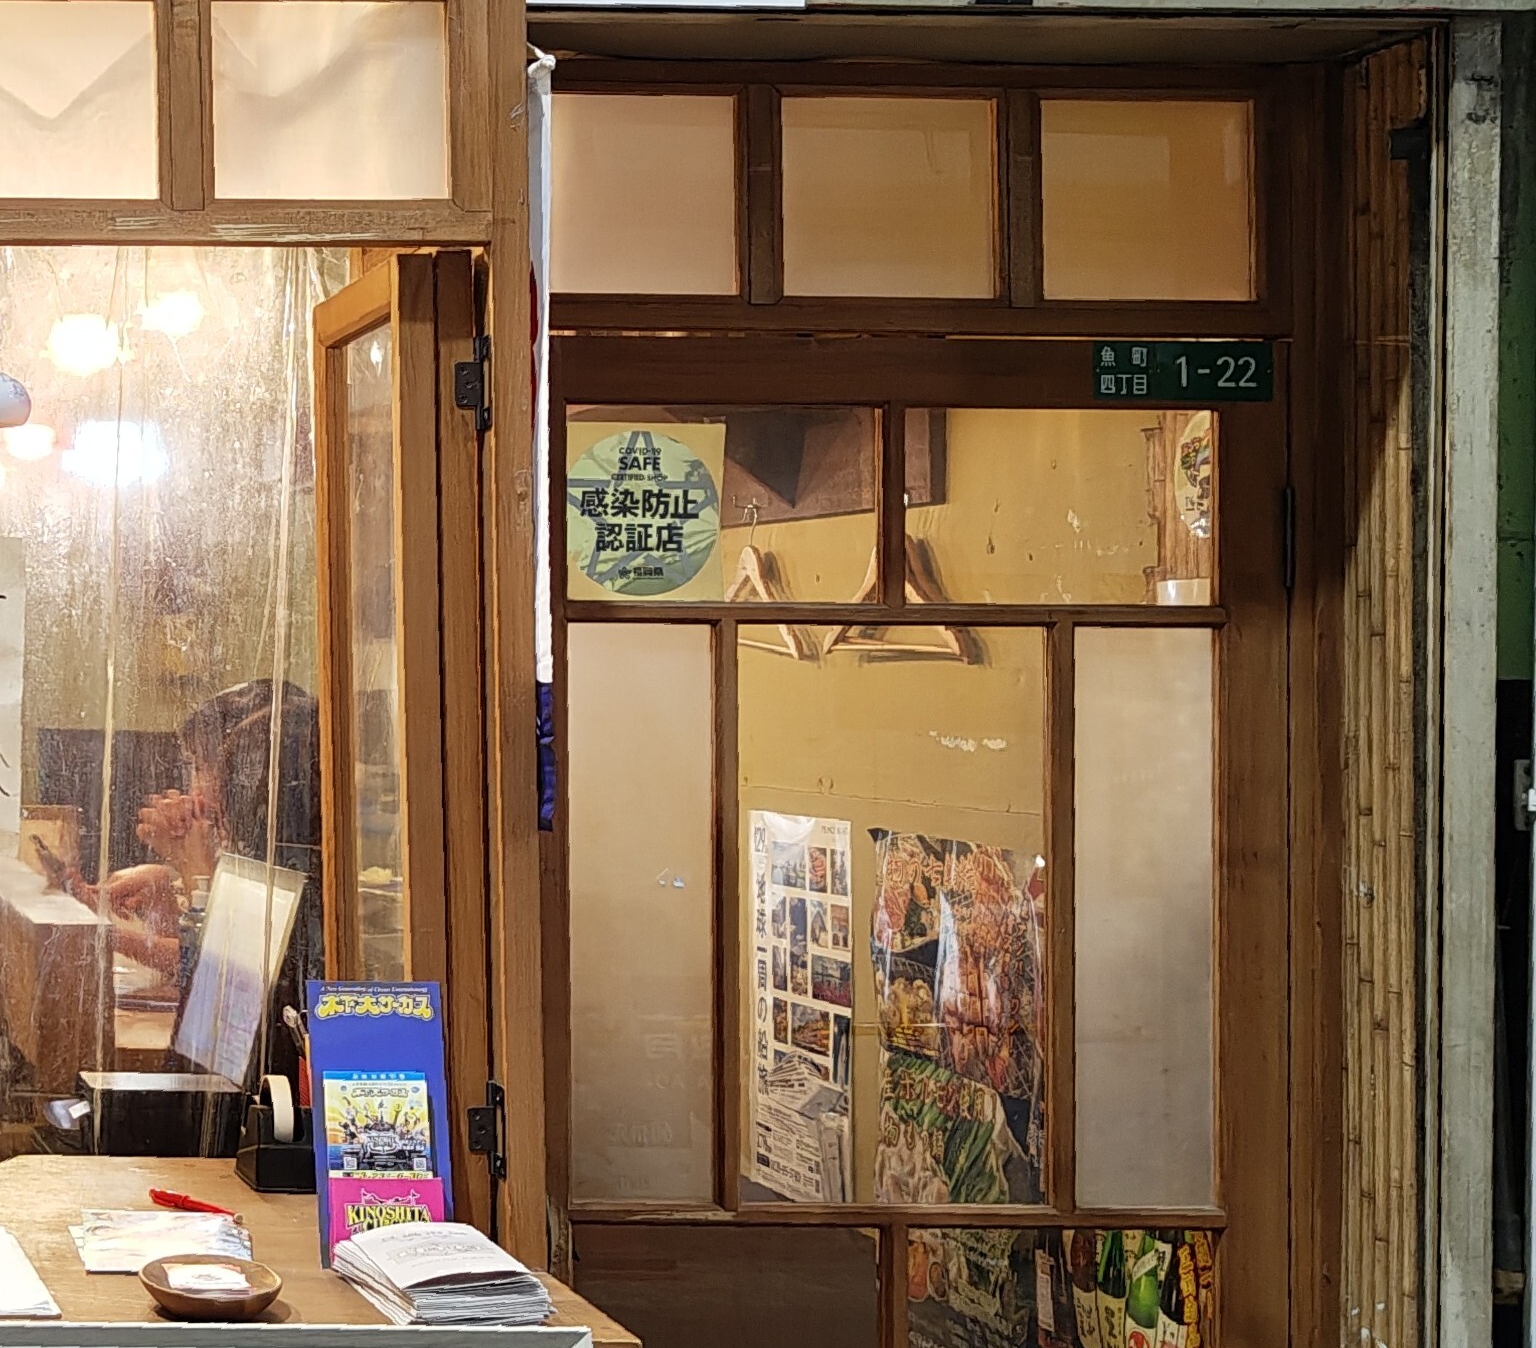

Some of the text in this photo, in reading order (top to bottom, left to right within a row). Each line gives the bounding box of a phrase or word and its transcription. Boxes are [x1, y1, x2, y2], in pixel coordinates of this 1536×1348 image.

[1100, 373, 1148, 396] 四丁目
[1174, 356, 1258, 388] 1-22
[618, 456, 662, 472] SAFE
[579, 488, 700, 520] 感染防止
[594, 521, 684, 553] 認証店
